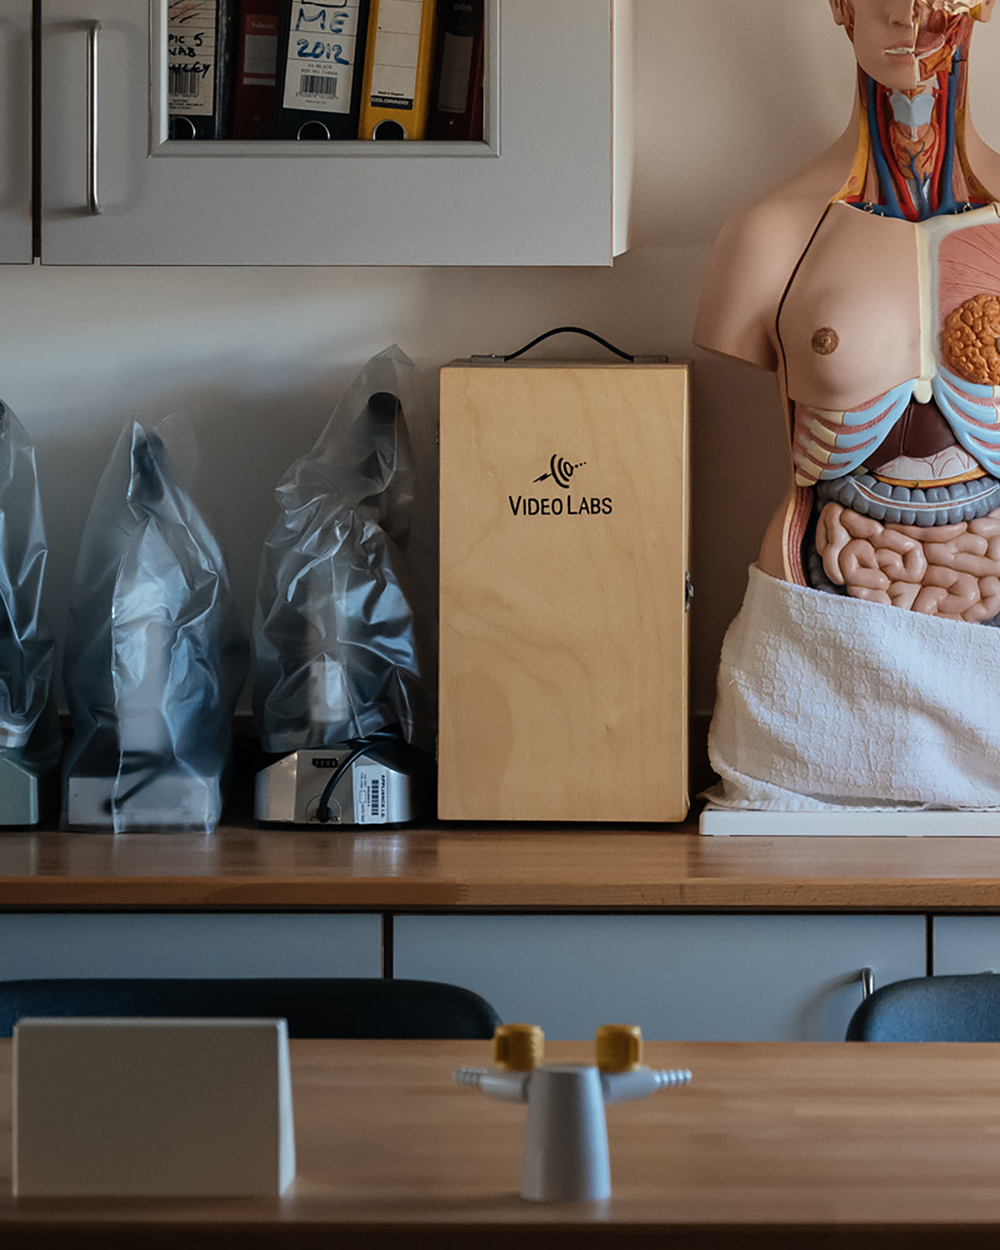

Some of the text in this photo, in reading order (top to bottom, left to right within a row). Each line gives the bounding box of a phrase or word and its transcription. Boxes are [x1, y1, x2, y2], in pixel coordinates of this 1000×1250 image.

[297, 38, 349, 65] 2012
[508, 495, 613, 516] VIDEO LABS
